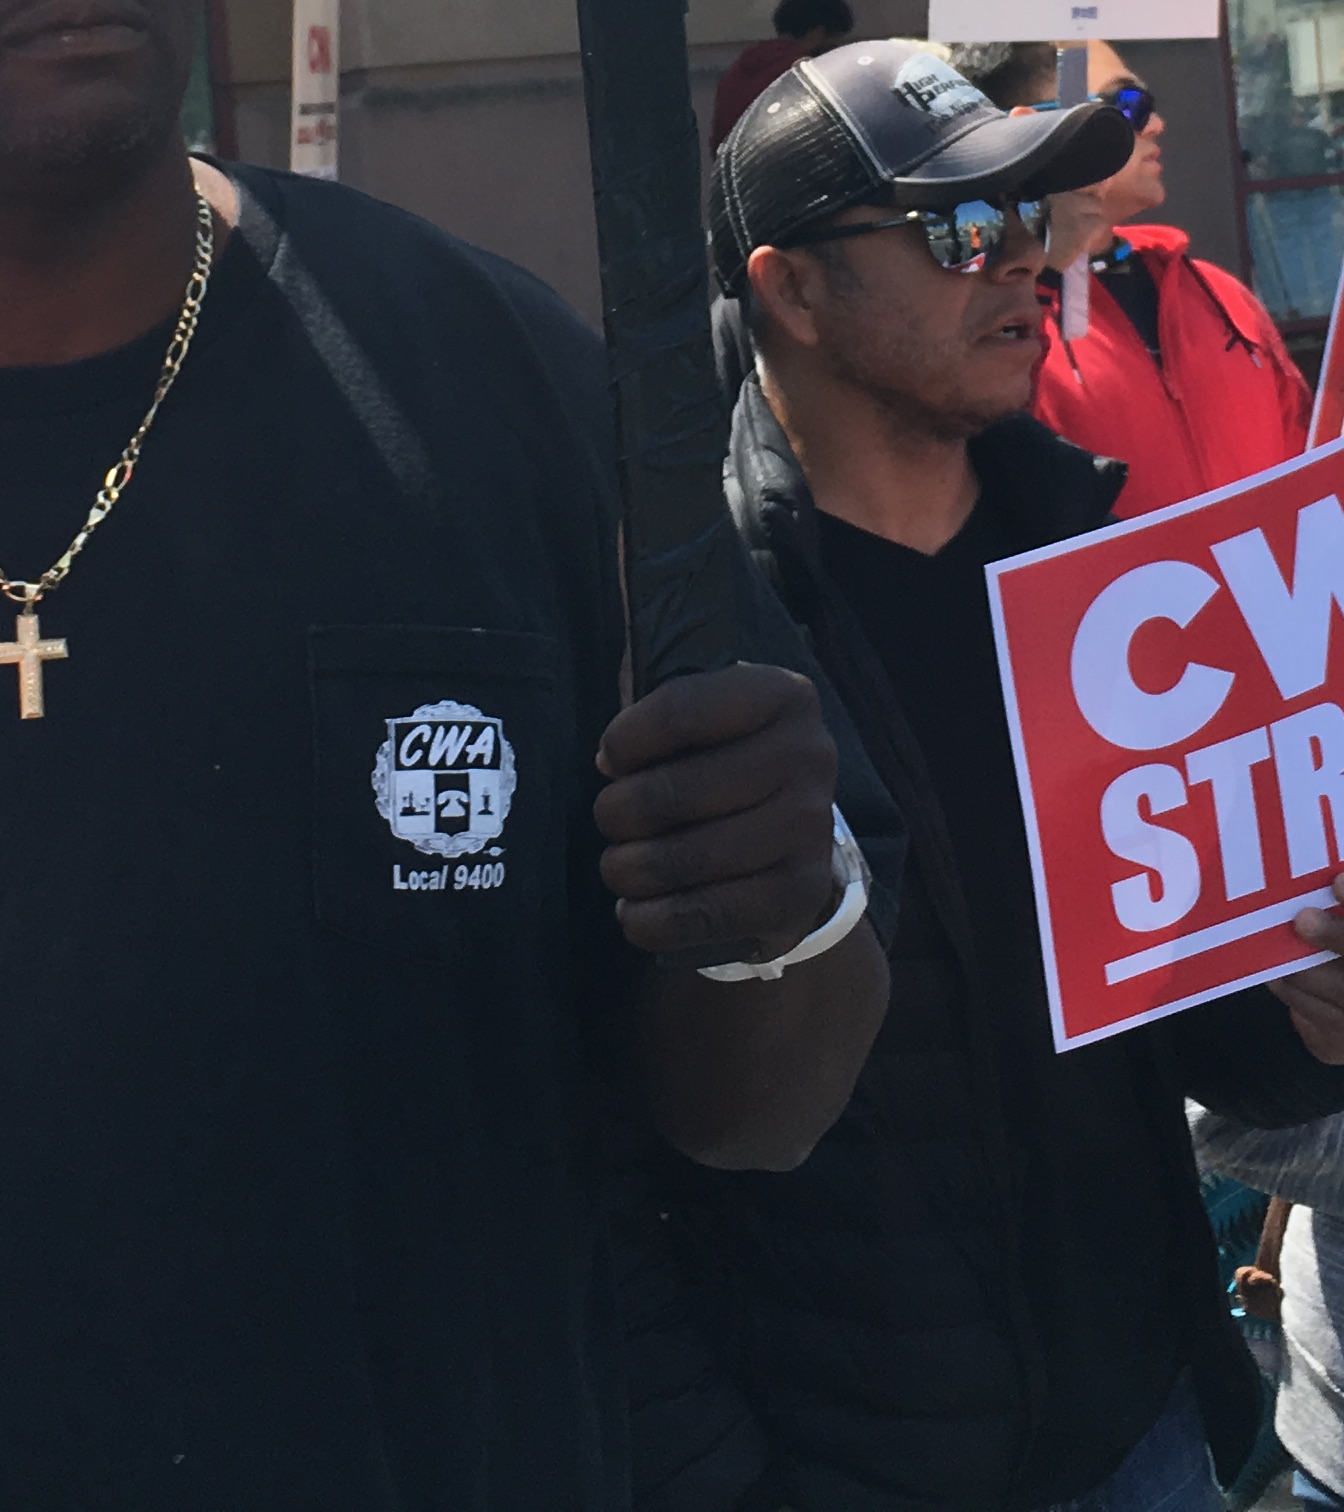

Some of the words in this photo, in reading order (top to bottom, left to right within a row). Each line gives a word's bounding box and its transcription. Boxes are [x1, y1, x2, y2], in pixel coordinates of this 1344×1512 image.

[399, 724, 495, 767] CWA
[393, 865, 448, 890] Local
[453, 862, 504, 890] 9400
